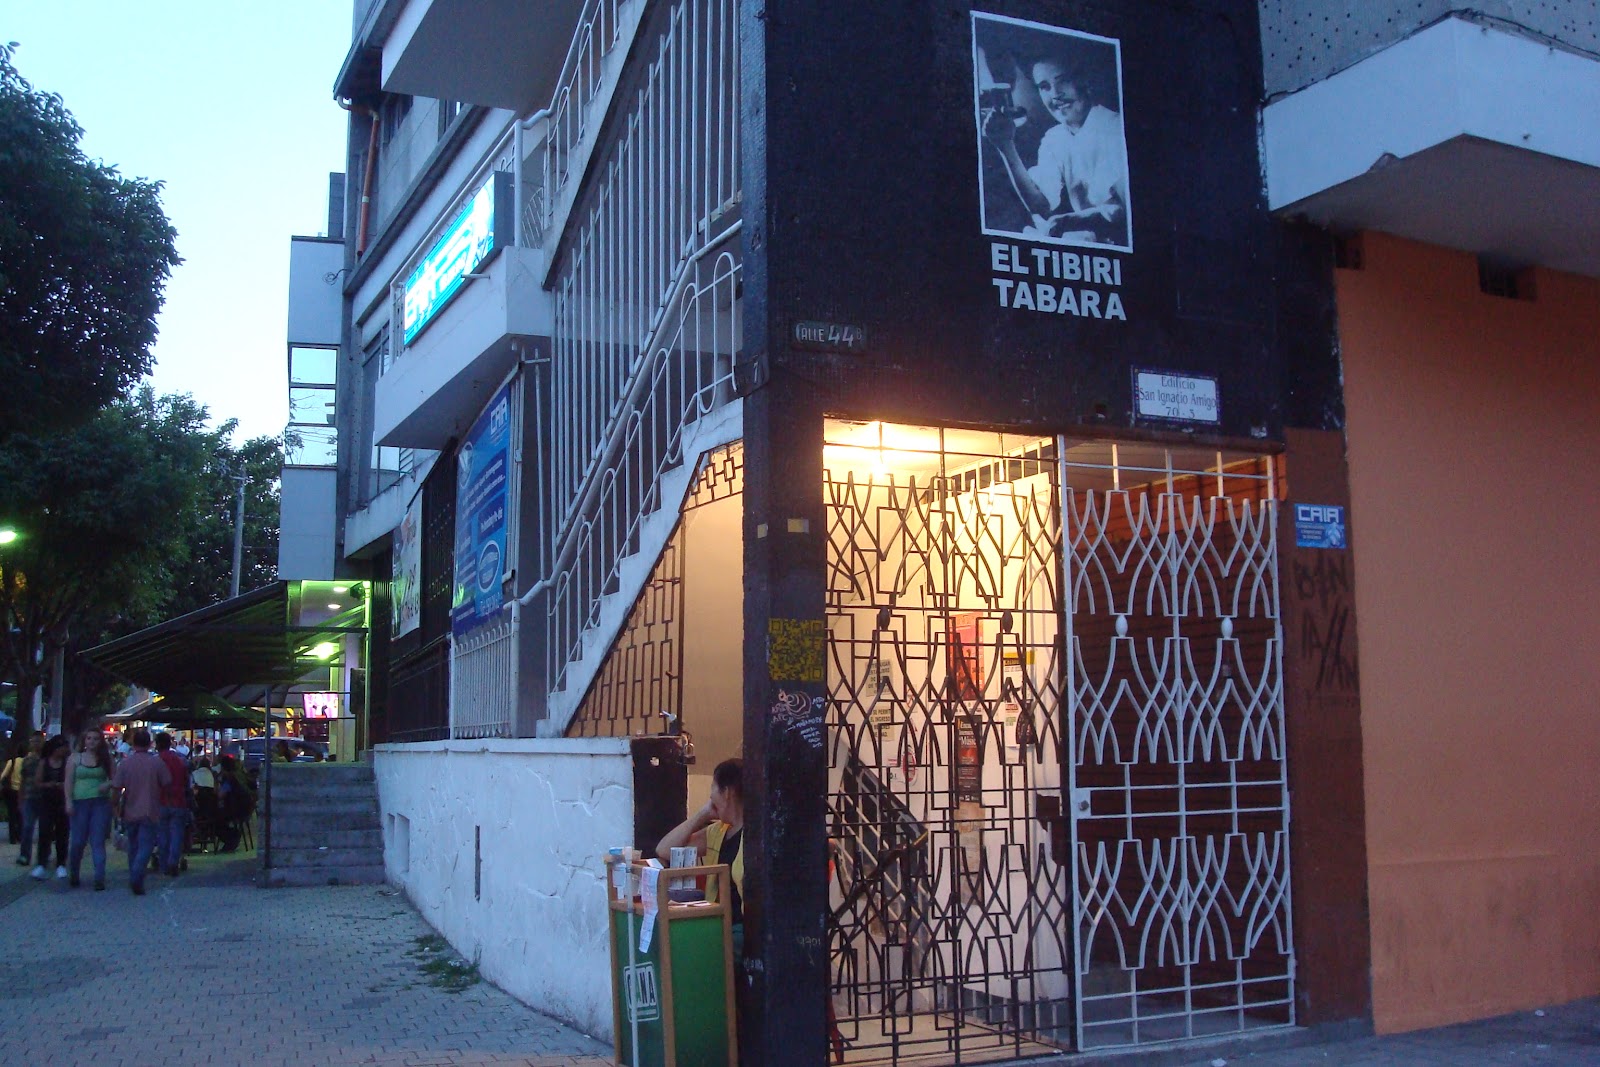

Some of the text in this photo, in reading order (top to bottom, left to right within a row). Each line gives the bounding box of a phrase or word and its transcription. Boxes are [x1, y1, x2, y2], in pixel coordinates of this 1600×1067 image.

[991, 242, 1122, 286] EL TIBIRI
[992, 278, 1127, 320] TABARA
[795, 322, 825, 342] CALLE
[828, 325, 854, 347] 44
[1161, 376, 1195, 390] Edificio
[1139, 388, 1155, 401] San
[1157, 389, 1188, 405] Ignacio
[1165, 407, 1179, 416] 70
